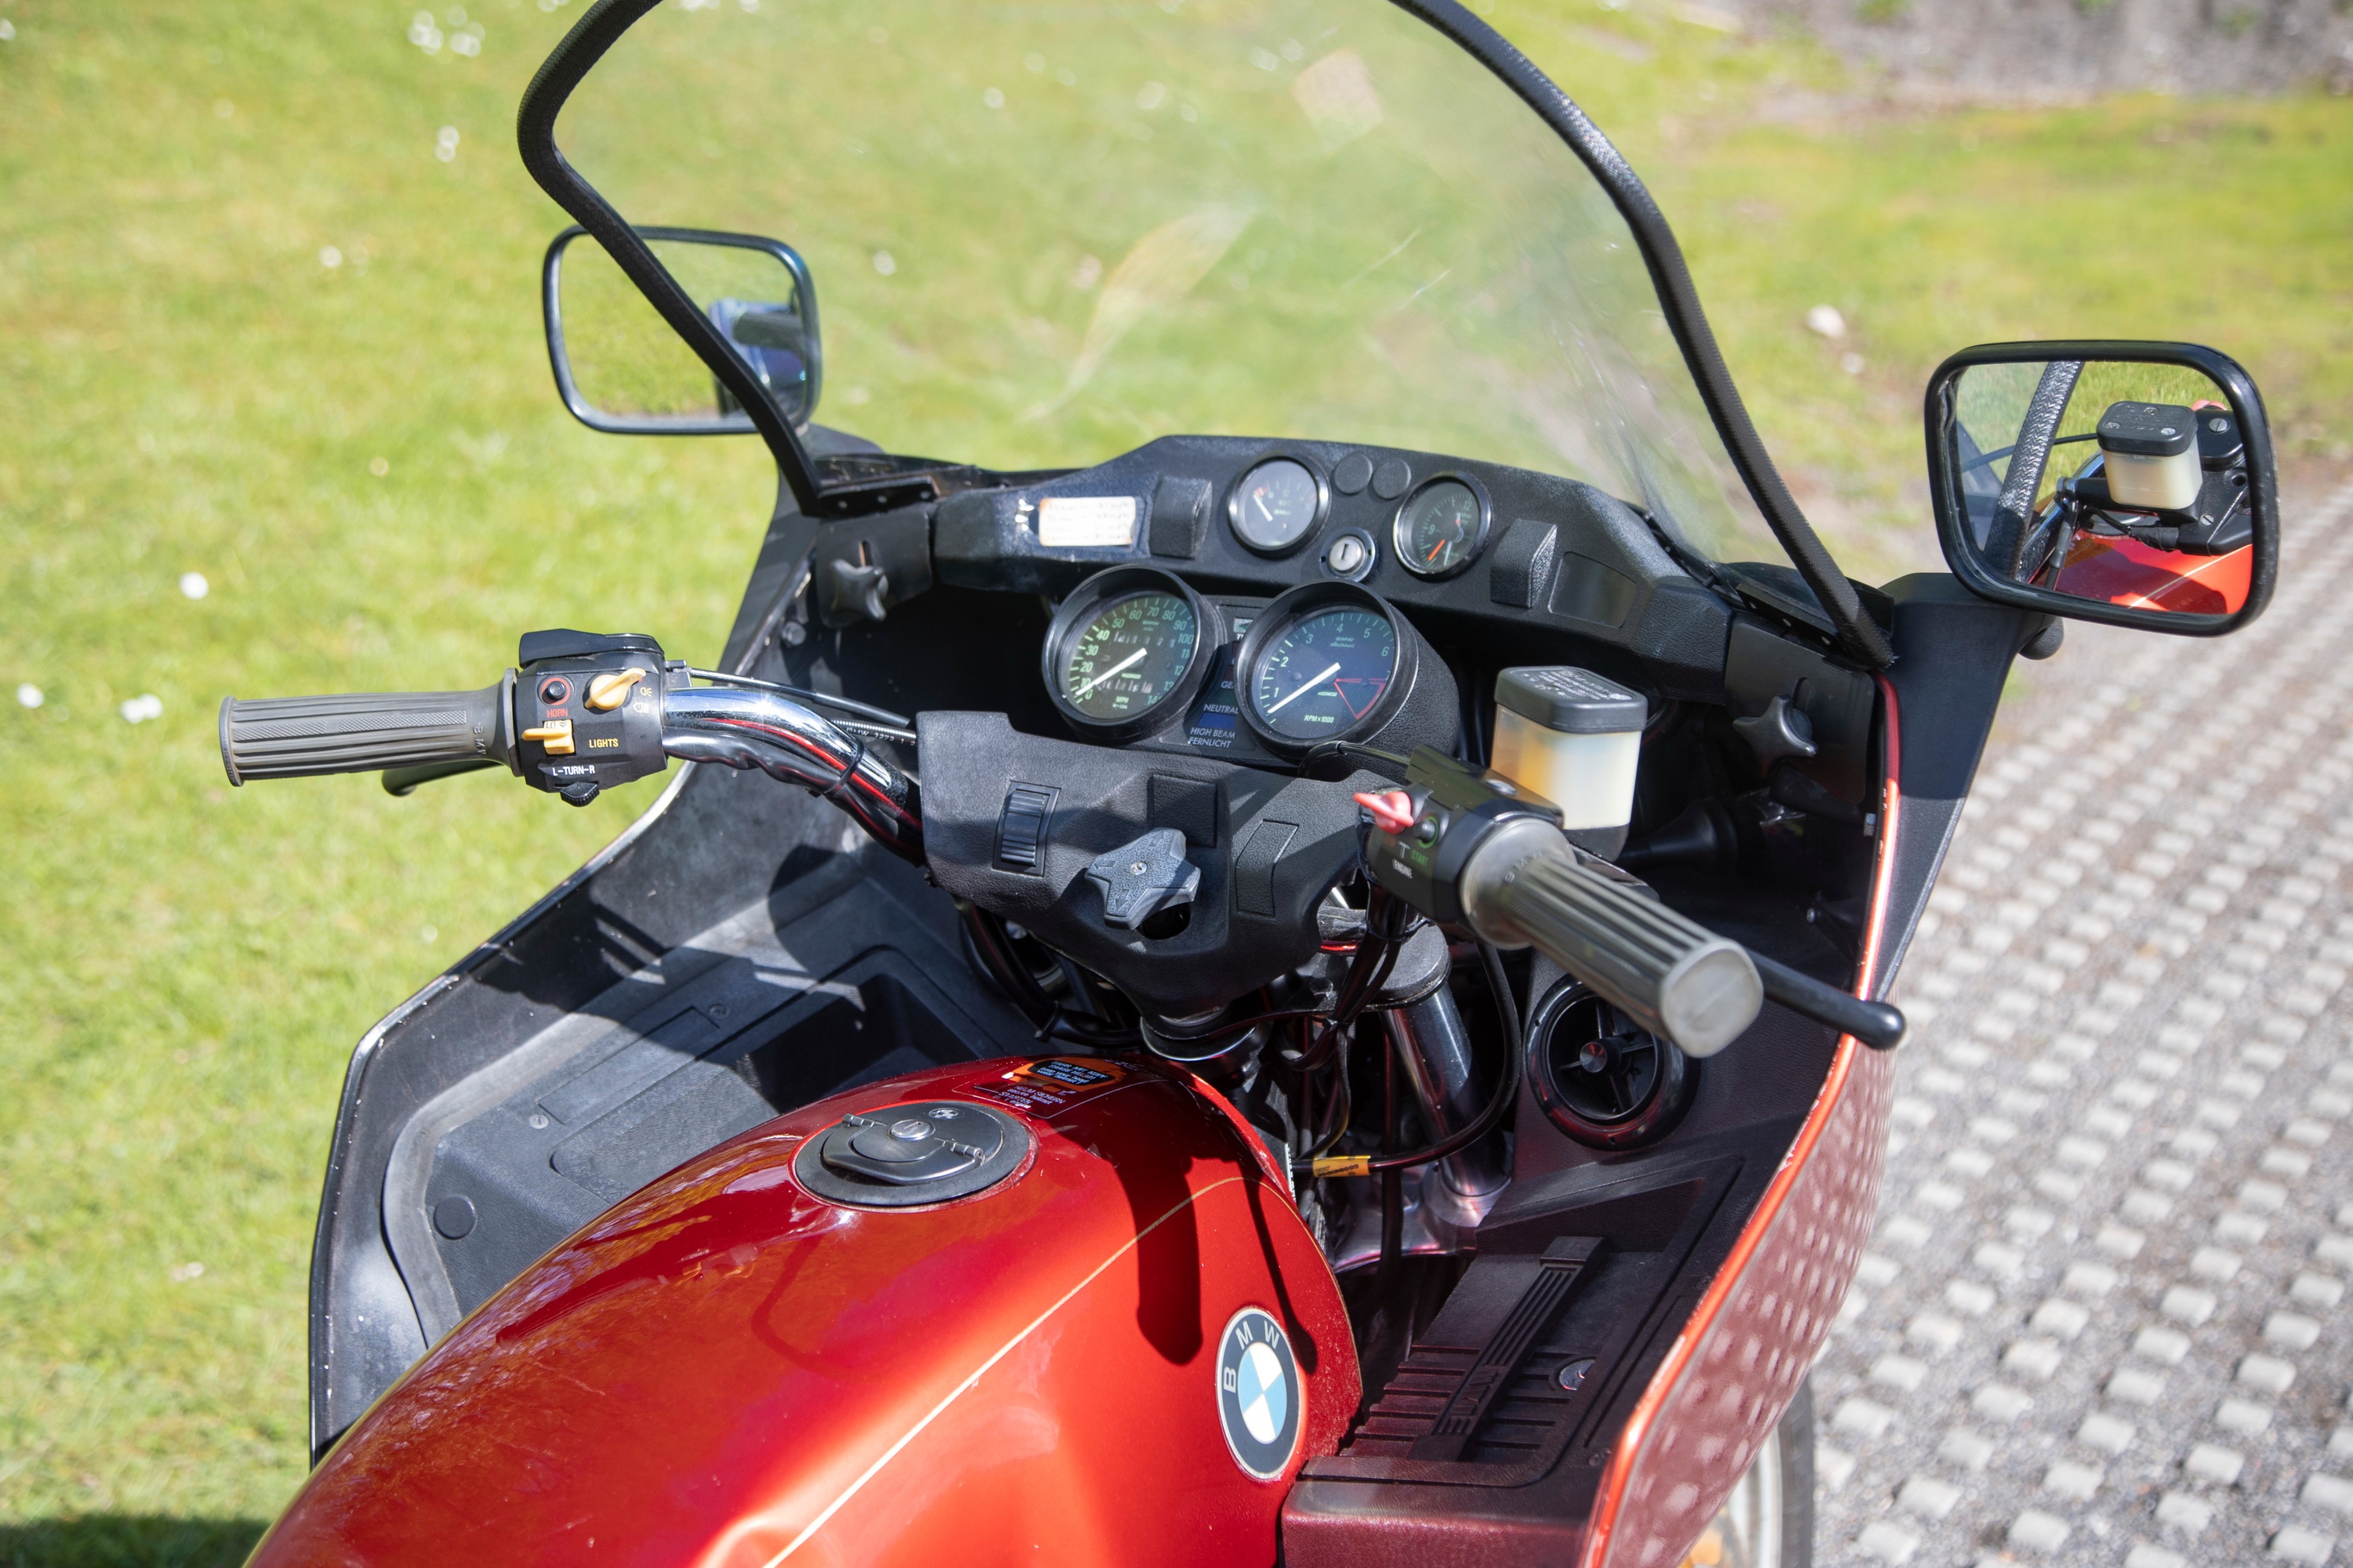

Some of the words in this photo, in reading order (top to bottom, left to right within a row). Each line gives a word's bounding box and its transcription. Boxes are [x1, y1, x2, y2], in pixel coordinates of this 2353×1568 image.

[1464, 501, 1472, 511] 12
[1429, 524, 1435, 535] 9
[1129, 610, 1142, 620] 60
[1148, 607, 1159, 617] 70
[1162, 610, 1176, 620] 80
[1113, 618, 1125, 628] 50
[1173, 620, 1187, 630] 90
[1337, 624, 1343, 633] 4
[1363, 628, 1371, 638] 5
[1096, 630, 1110, 641] 40
[1179, 634, 1194, 645] 100
[1306, 634, 1314, 644] 3
[1085, 645, 1099, 656] 30
[1181, 649, 1191, 659] 11
[1382, 647, 1390, 657] 6
[1080, 662, 1093, 672] 20
[1281, 657, 1289, 667] 2
[1221, 681, 1234, 689] GE
[1085, 690, 1093, 700] 0
[1274, 688, 1279, 698] 1
[1148, 696, 1161, 705] 14
[547, 708, 568, 718] HORN
[1203, 704, 1239, 714] NEUTRAL
[1190, 727, 1212, 736] HIGH
[1213, 730, 1236, 739] BEAM
[589, 738, 619, 748] LIGHTS
[1189, 737, 1232, 748] FERNLICHT
[1411, 850, 1429, 866] START
[1392, 858, 1412, 878] ENGINE
[999, 1091, 1033, 1104] STARTEN
[1224, 1321, 1279, 1393] BMW
